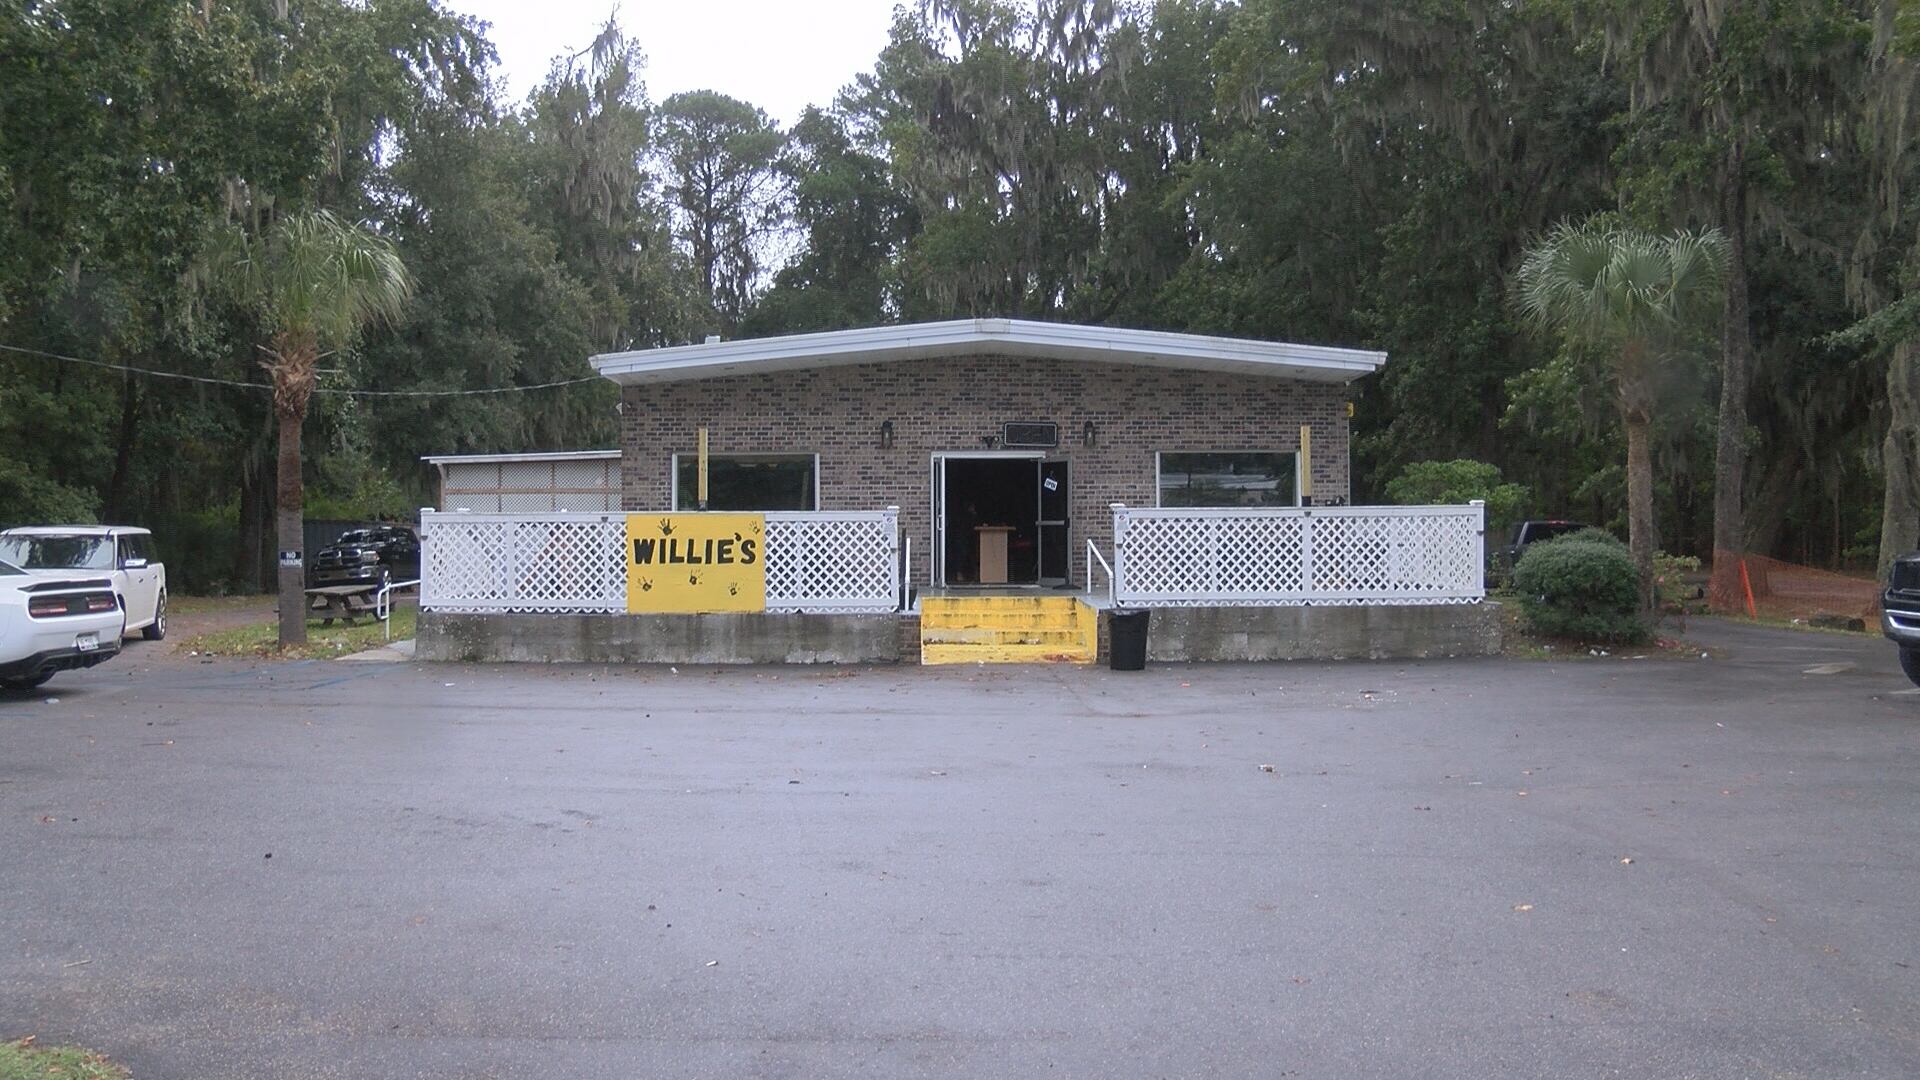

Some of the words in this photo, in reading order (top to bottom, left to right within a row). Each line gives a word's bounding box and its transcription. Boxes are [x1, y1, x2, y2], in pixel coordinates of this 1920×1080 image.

[1045, 480, 1057, 489] OPEN
[633, 533, 756, 565] WILLIE'S
[286, 551, 296, 559] NO
[280, 559, 302, 567] PARKING
